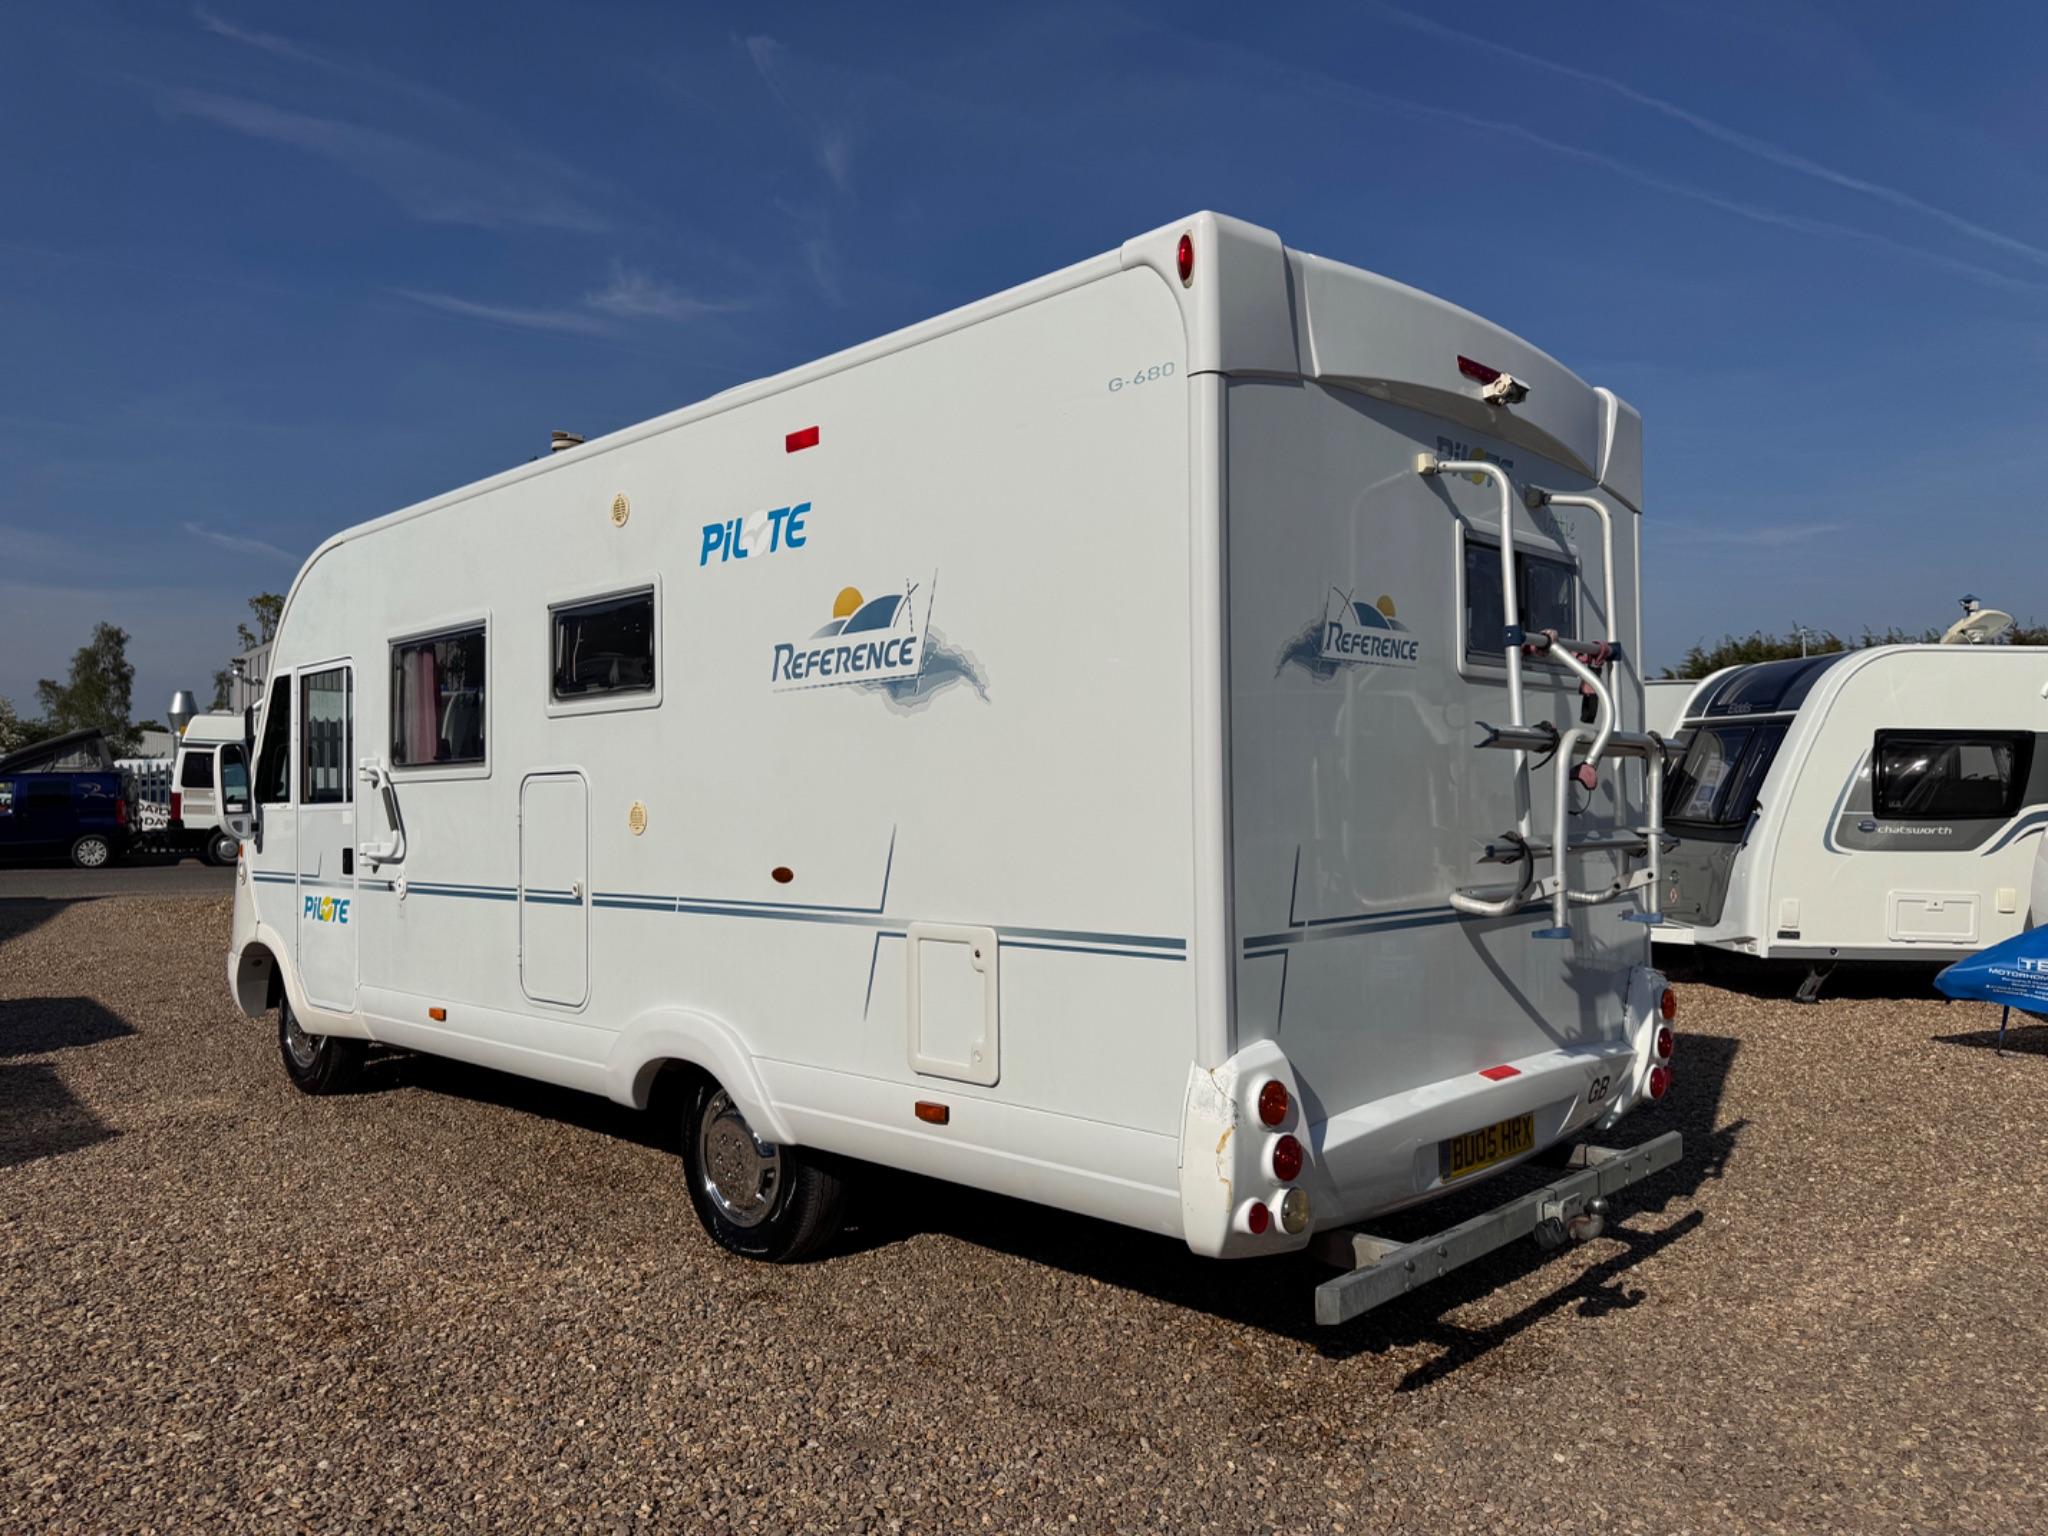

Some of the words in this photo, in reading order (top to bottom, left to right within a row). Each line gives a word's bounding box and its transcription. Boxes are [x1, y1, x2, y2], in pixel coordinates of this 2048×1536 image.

[1108, 362, 1175, 392] G-680
[1326, 621, 1419, 661] REFERENCE
[772, 636, 917, 682] REFERENCE
[1878, 824, 1952, 834] chatsworth
[1588, 1075, 1610, 1104] GB
[1502, 1115, 1532, 1153] HRX
